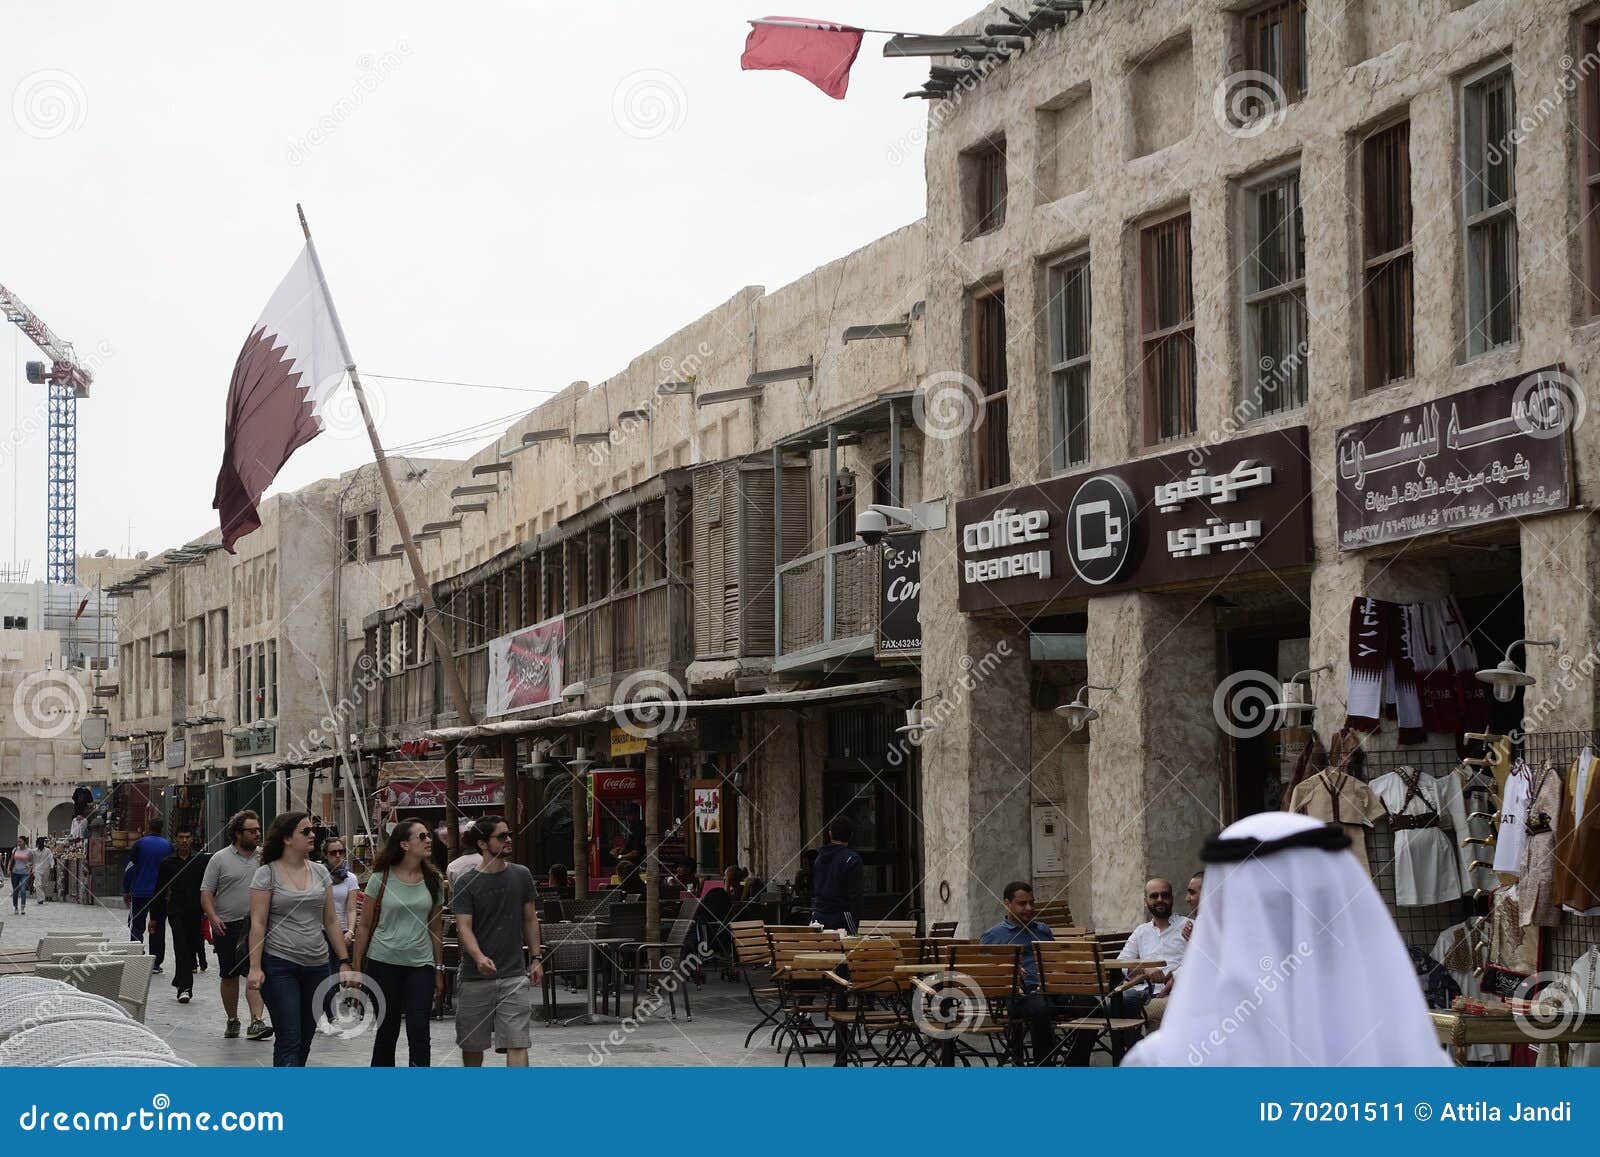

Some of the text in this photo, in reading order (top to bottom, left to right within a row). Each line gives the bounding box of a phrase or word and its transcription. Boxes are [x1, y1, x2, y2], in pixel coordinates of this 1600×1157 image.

[1154, 459, 1272, 514] كوفي
[963, 508, 1050, 552] coffee
[964, 550, 1051, 584] beanery
[1501, 814, 1515, 824] AT
